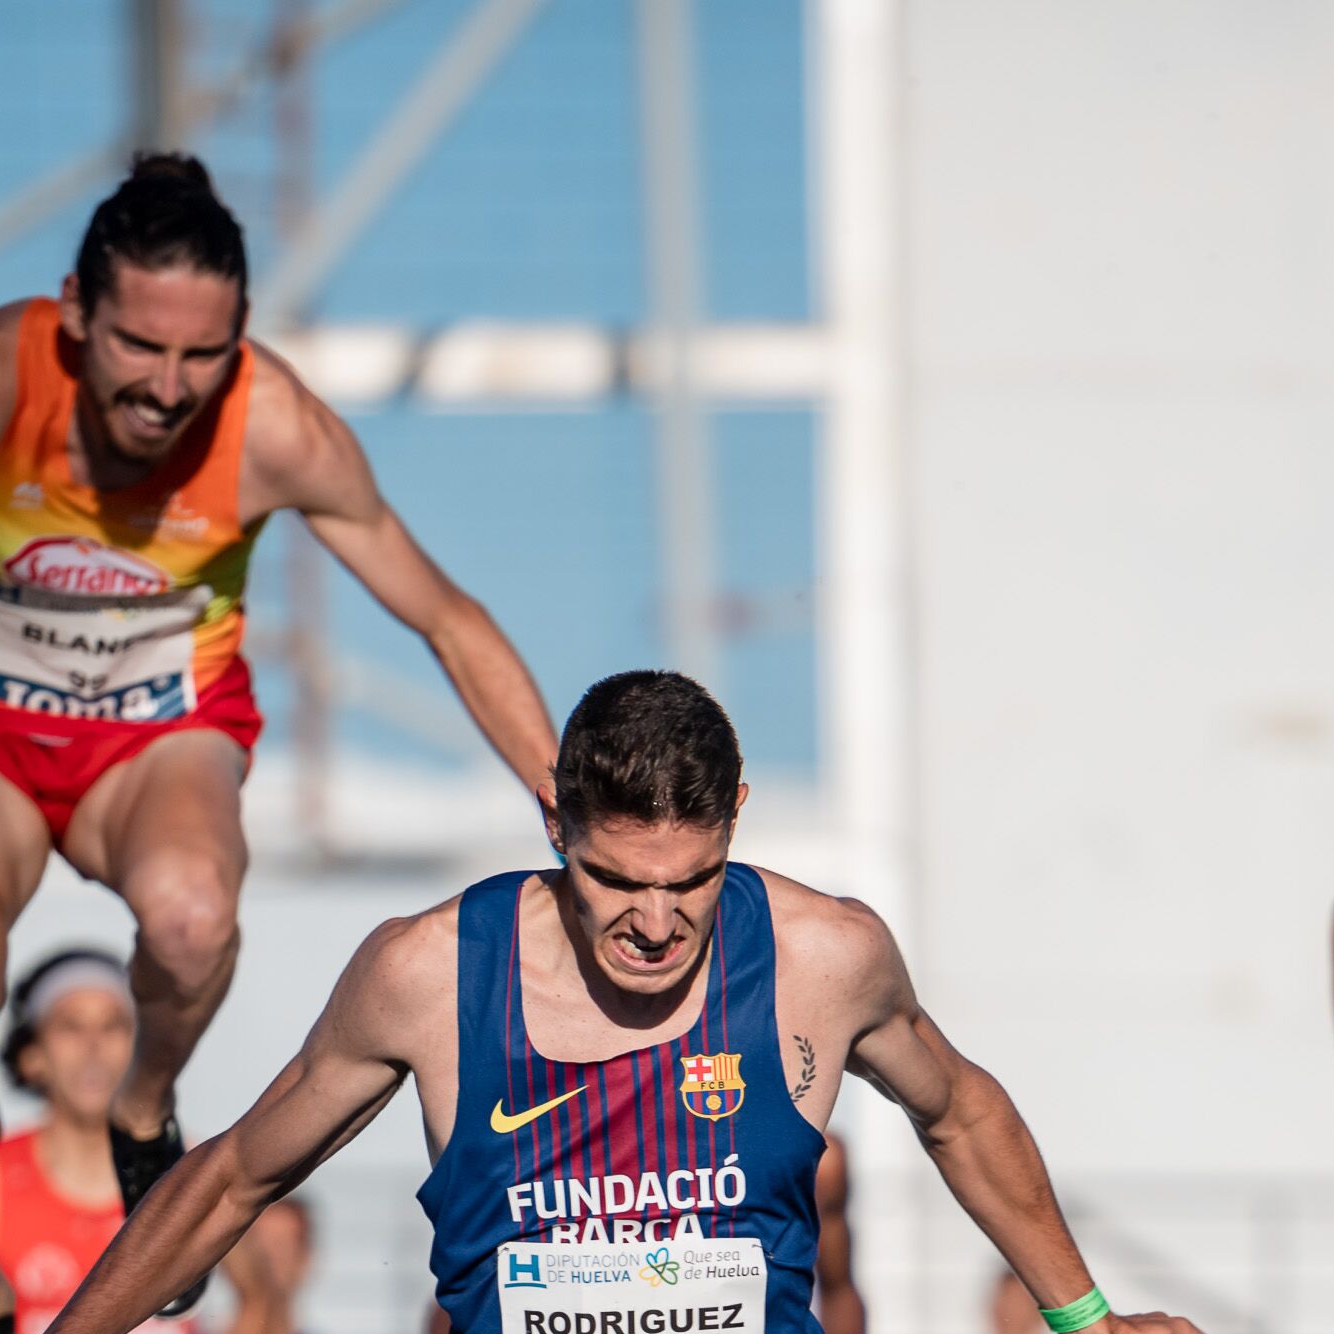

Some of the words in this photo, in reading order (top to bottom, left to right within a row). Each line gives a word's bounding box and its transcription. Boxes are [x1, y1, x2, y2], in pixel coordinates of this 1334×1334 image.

[507, 1153, 746, 1223] FUNDACIÓ
[546, 1252, 641, 1269] DIPUTACIÓN
[683, 1249, 711, 1265] Que
[715, 1250, 741, 1262] sea
[547, 1270, 567, 1283] DE
[571, 1270, 632, 1284] HUELVA
[684, 1268, 702, 1281] de
[706, 1264, 760, 1279] Huelva
